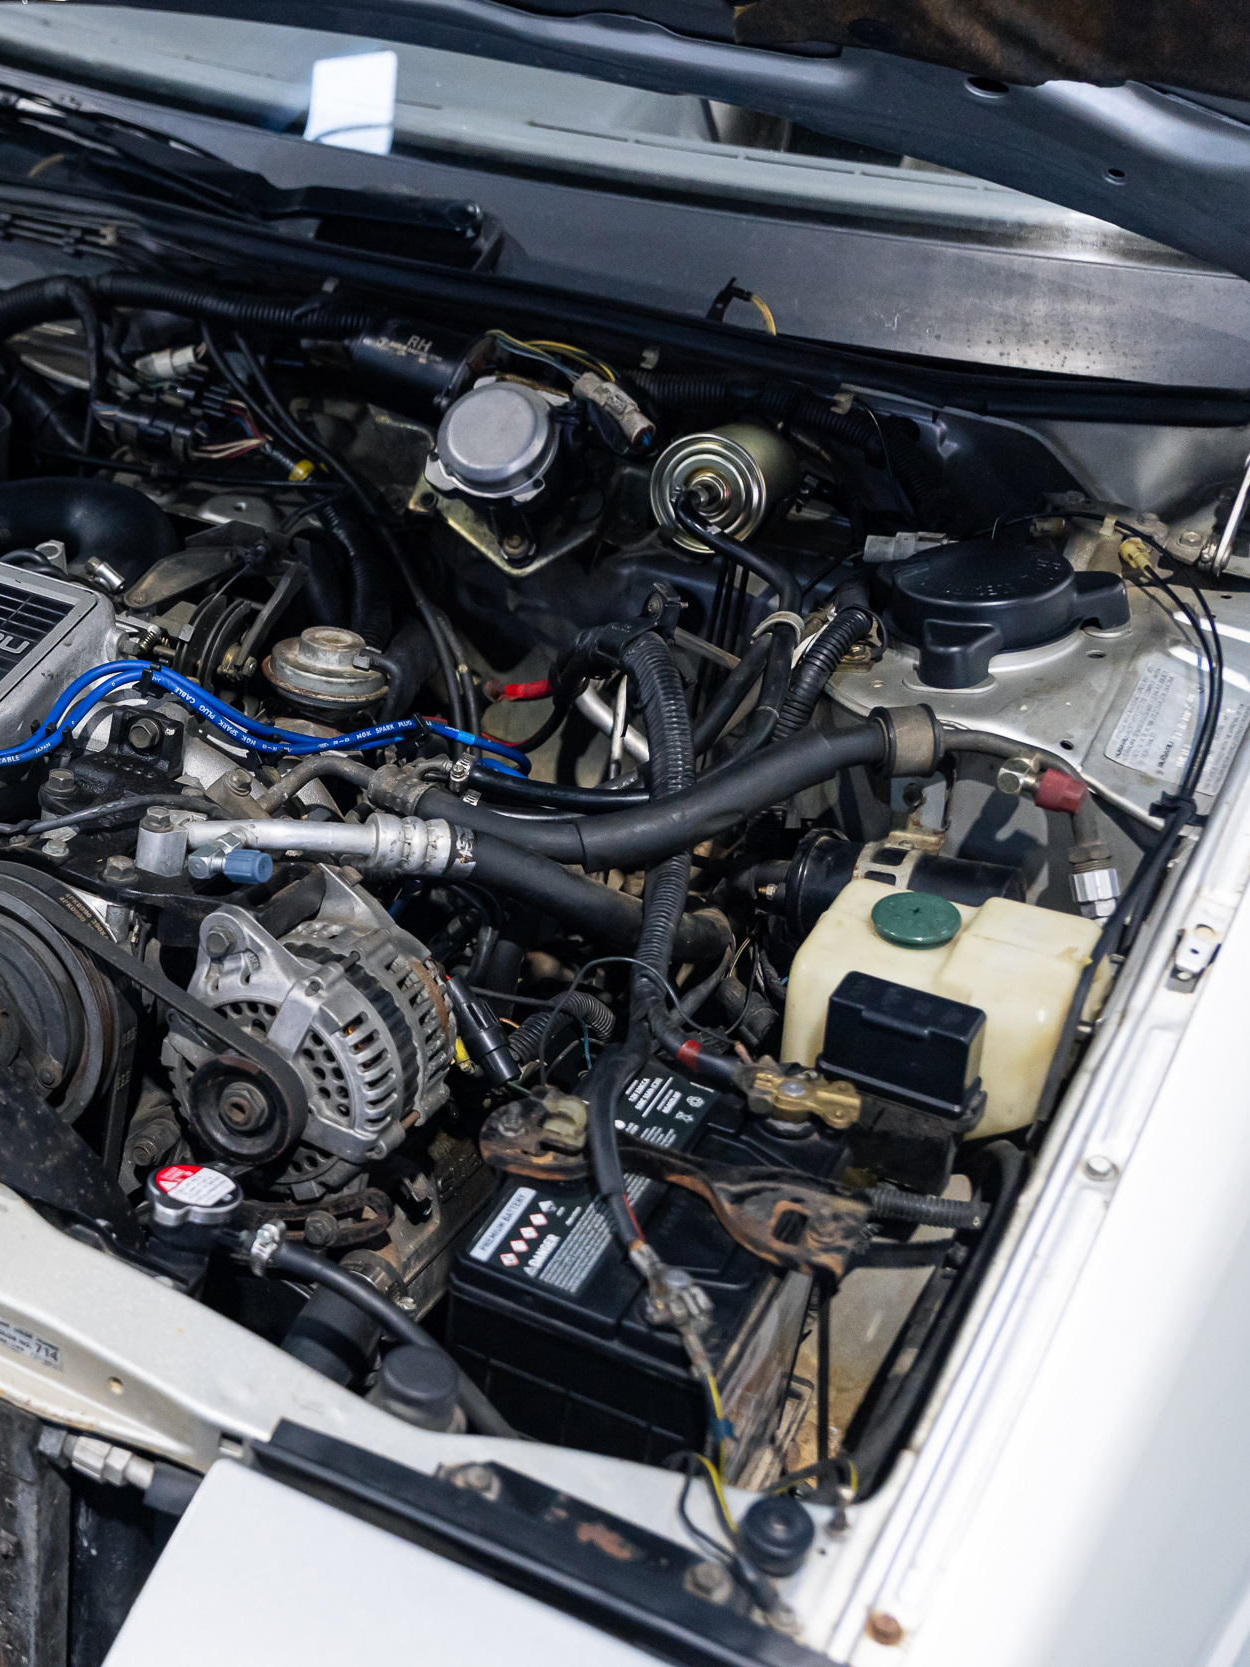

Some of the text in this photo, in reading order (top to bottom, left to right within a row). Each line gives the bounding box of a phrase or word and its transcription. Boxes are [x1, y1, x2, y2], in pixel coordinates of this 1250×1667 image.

[406, 334, 434, 352] RH
[174, 686, 196, 704] CABLE
[199, 705, 216, 719] PLUG
[219, 719, 238, 736] SPARK
[376, 724, 394, 734] SPARK
[398, 720, 412, 728] PLUG
[35, 742, 51, 754] JAPAN
[479, 1194, 527, 1251] PREMIUM BATTERY
[528, 1234, 560, 1268] DANGER
[35, 1342, 58, 1361] 714
